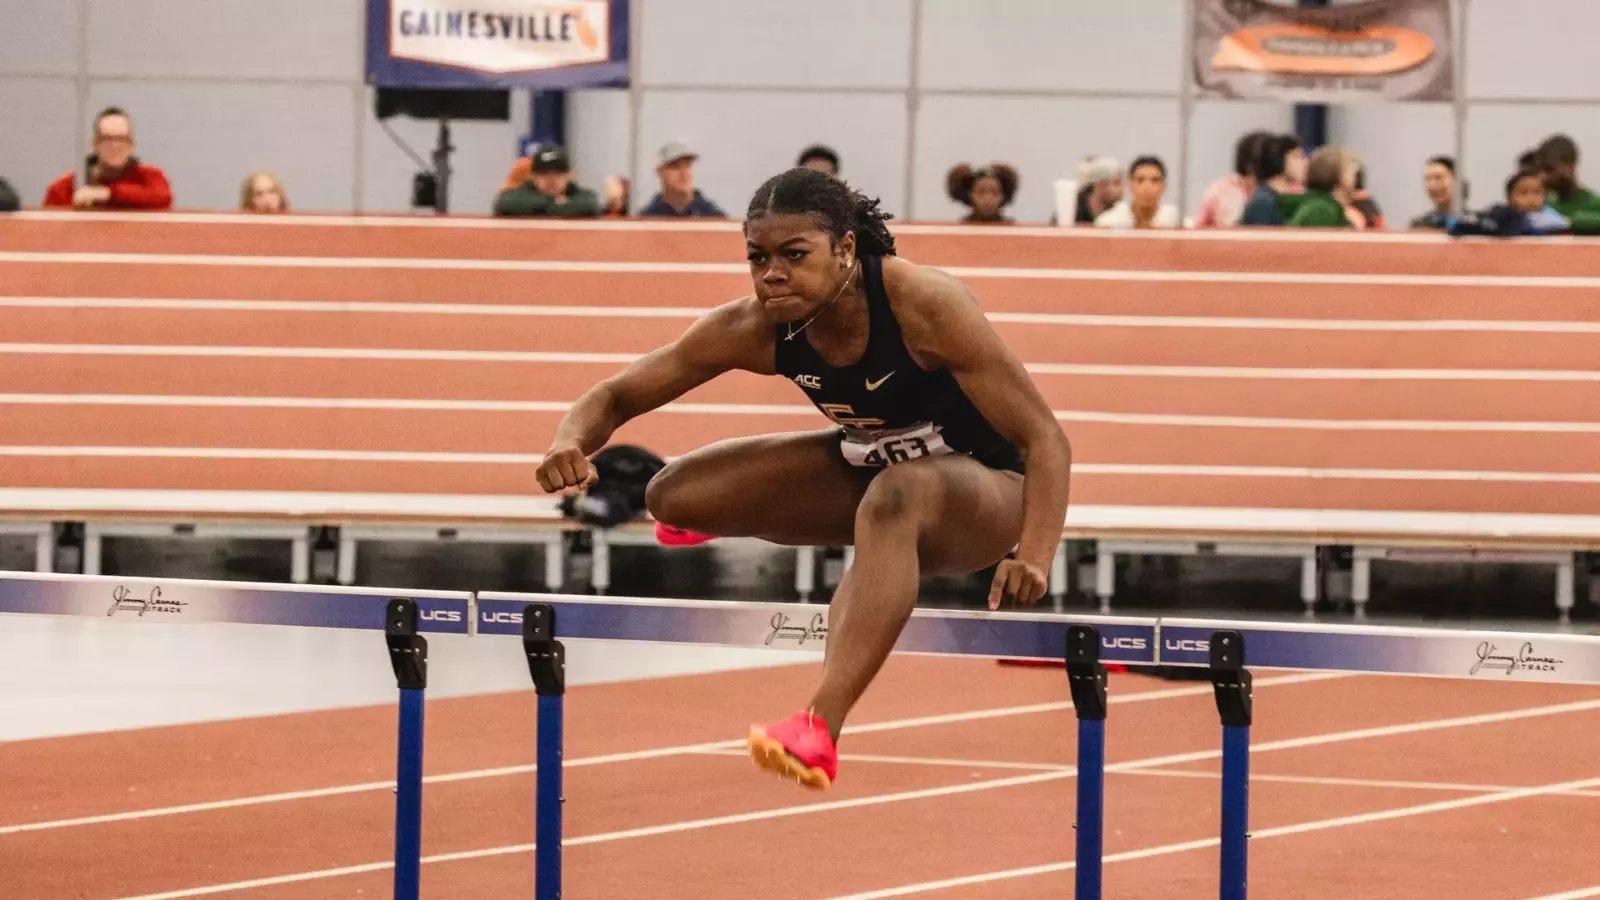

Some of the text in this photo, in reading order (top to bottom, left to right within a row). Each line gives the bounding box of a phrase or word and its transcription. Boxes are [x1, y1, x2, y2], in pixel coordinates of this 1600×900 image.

[399, 10, 573, 42] GAINESVILLE
[794, 374, 822, 387] ACC
[863, 436, 931, 468] 463
[420, 609, 462, 622] UCS
[482, 611, 524, 624] UCS
[1102, 636, 1147, 649] UCS
[1165, 639, 1211, 651] UCS
